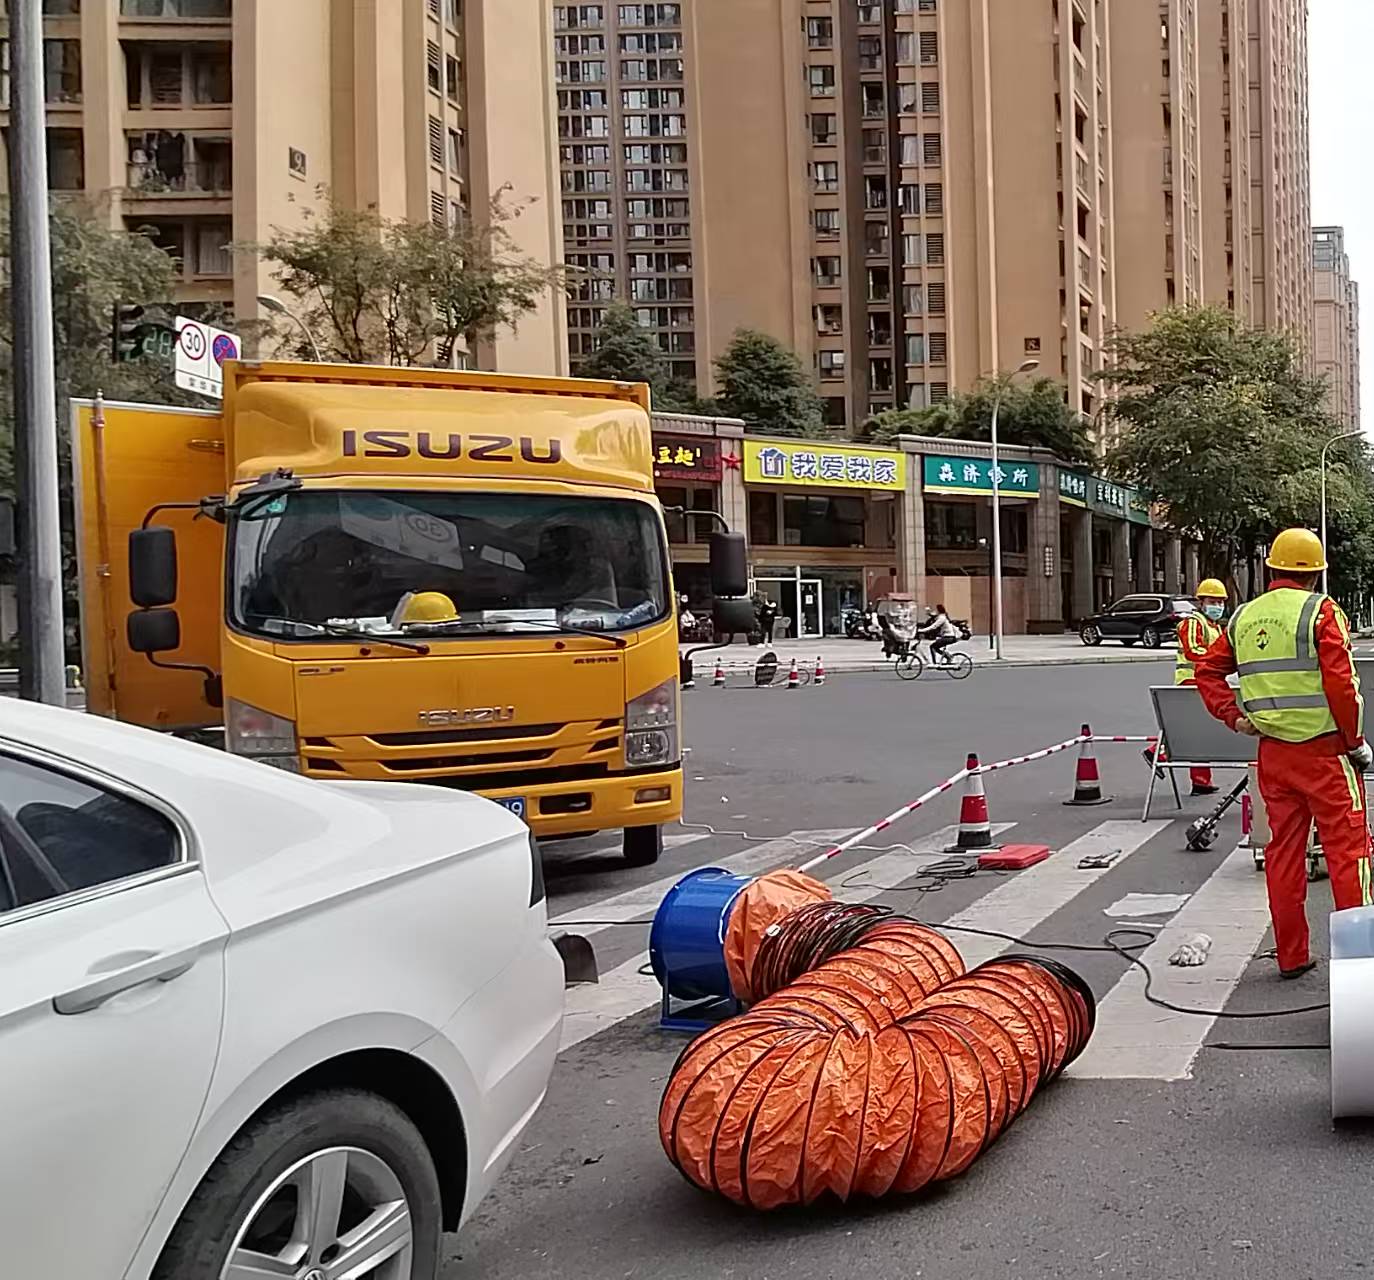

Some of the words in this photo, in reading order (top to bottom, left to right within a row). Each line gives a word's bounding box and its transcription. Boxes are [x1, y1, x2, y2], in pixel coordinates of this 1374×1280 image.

[142, 327, 171, 357] 28
[185, 331, 201, 352] 30
[343, 430, 561, 464] ISUZU
[792, 452, 896, 483] 我爱我家
[418, 706, 515, 726] ISUZU
